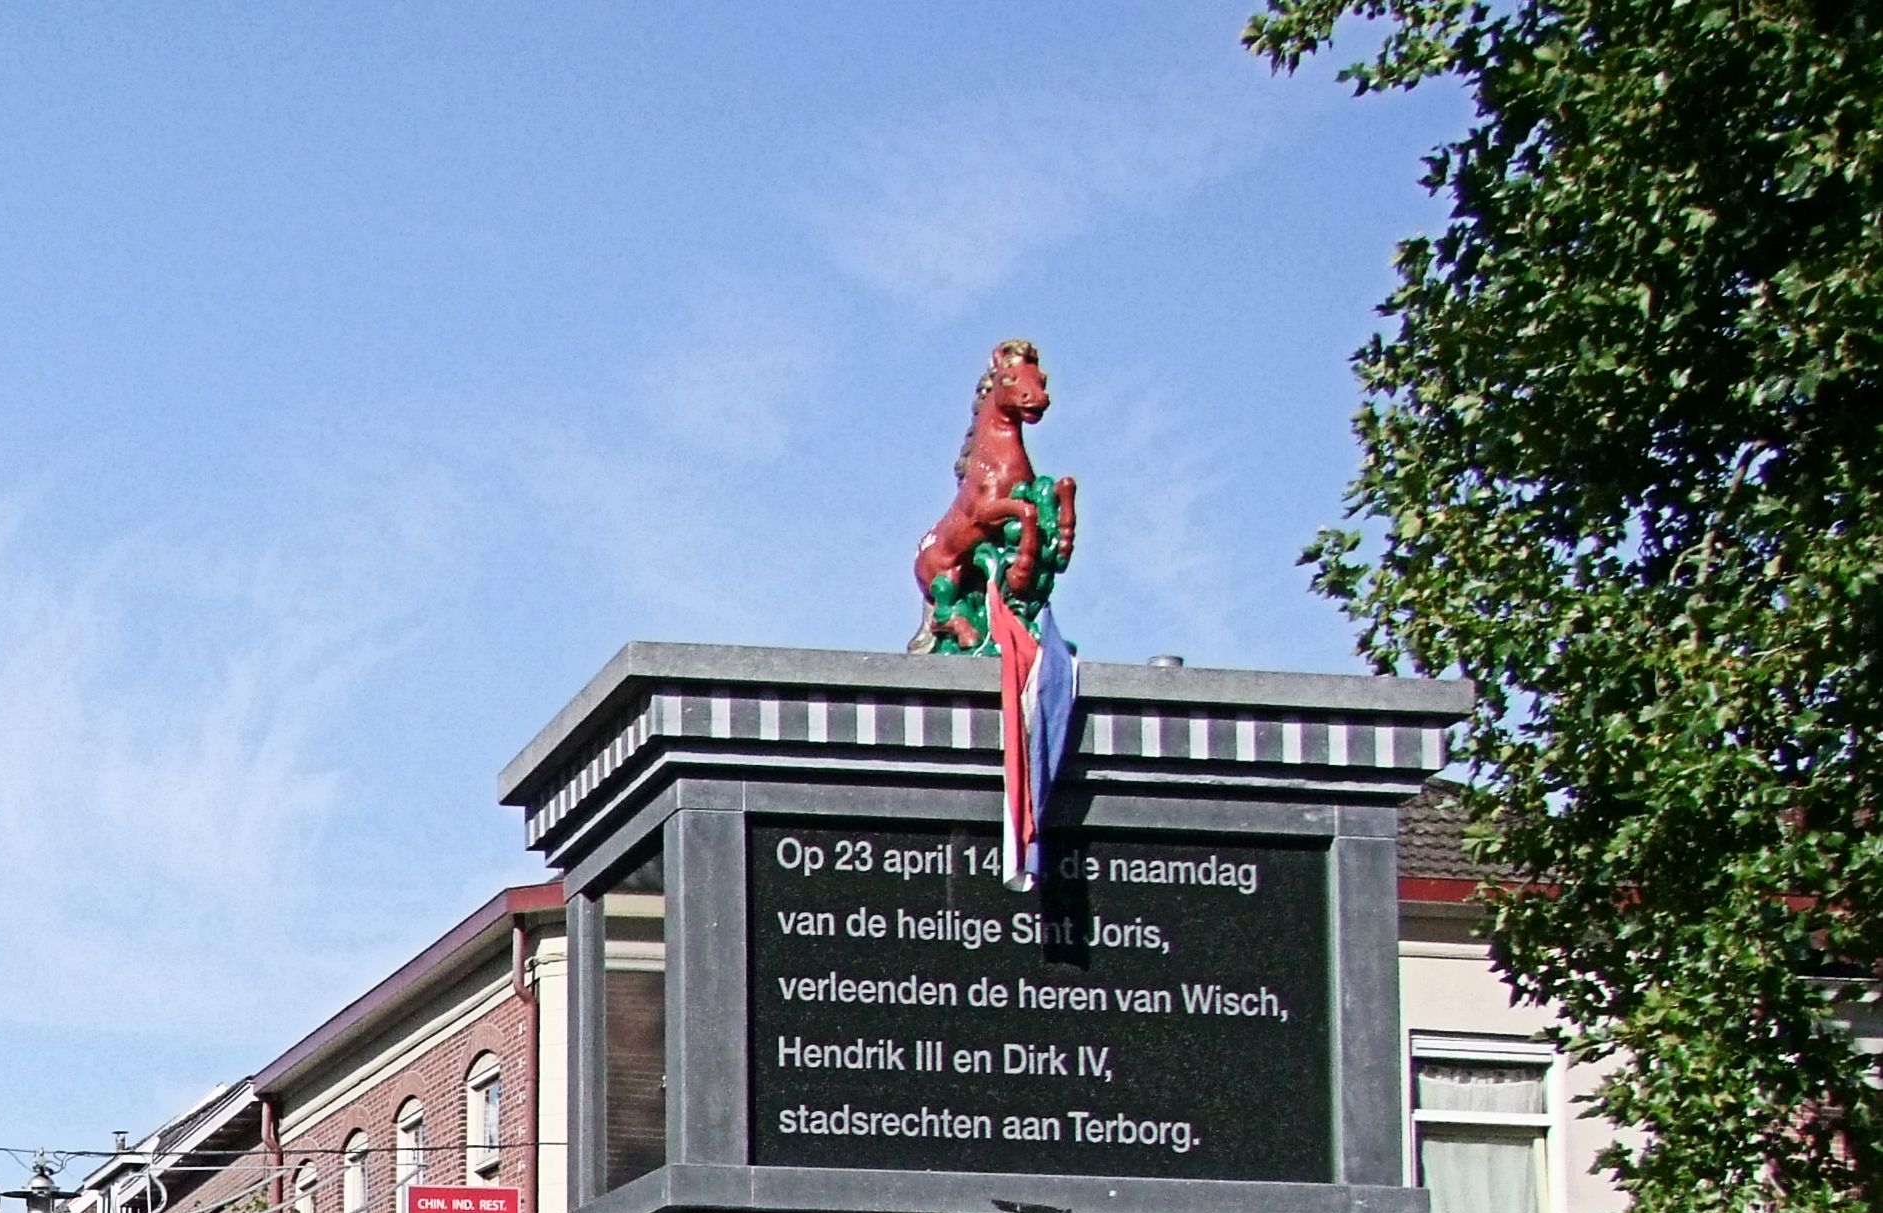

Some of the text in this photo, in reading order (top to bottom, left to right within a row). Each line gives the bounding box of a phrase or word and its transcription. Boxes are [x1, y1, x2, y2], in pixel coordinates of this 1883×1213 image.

[776, 836, 825, 877] Op
[834, 839, 874, 872] 23
[882, 843, 954, 881] april
[1059, 849, 1101, 881] de
[1109, 855, 1258, 895] naamdag
[777, 907, 1170, 955] van de heilige Sint Joris,
[777, 970, 1289, 1023] verleenden de heren van Wisch,
[778, 1035, 1113, 1083] Hendrik III en Dirk IV,
[778, 1103, 1201, 1154] stadsrechten aan Terborg.
[417, 1198, 507, 1211] CHIN. IND. REST.
